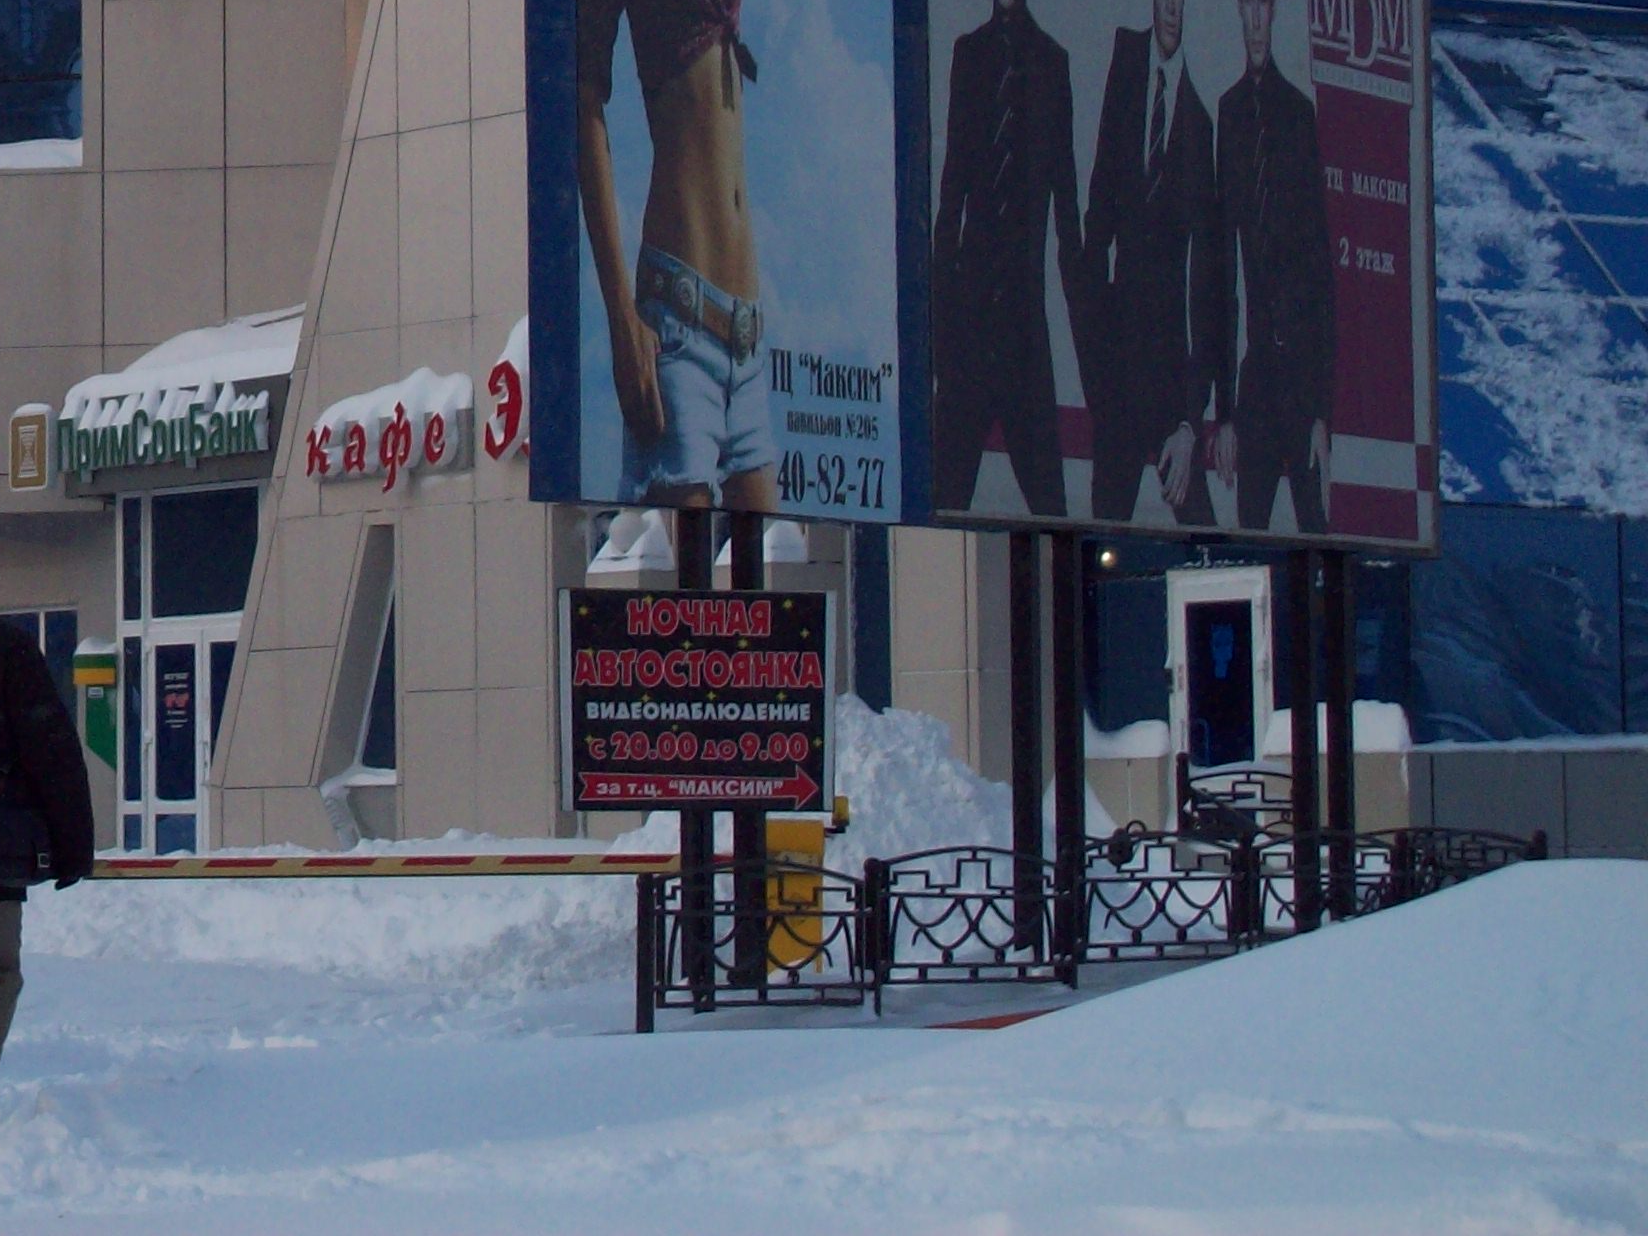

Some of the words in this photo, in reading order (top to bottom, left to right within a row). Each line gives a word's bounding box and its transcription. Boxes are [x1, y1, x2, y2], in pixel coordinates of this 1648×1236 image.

[1352, 171, 1408, 204] МАКСИМ
[1339, 236, 1350, 266] 2
[1356, 247, 1395, 275] этаж
[769, 348, 793, 399] ТЦ
[56, 402, 262, 473] ПримСоцБанк
[306, 401, 447, 494] кафе
[777, 450, 885, 509] 40-82-77
[626, 598, 771, 637] НОЧНАЯ
[574, 649, 824, 689] АВТОСТОЯНКА
[586, 700, 812, 722] ВИДЕОНАБЛЮДЕНИЕ
[610, 731, 698, 761] 20.00
[739, 731, 809, 761] 9.00
[596, 782, 622, 796] за
